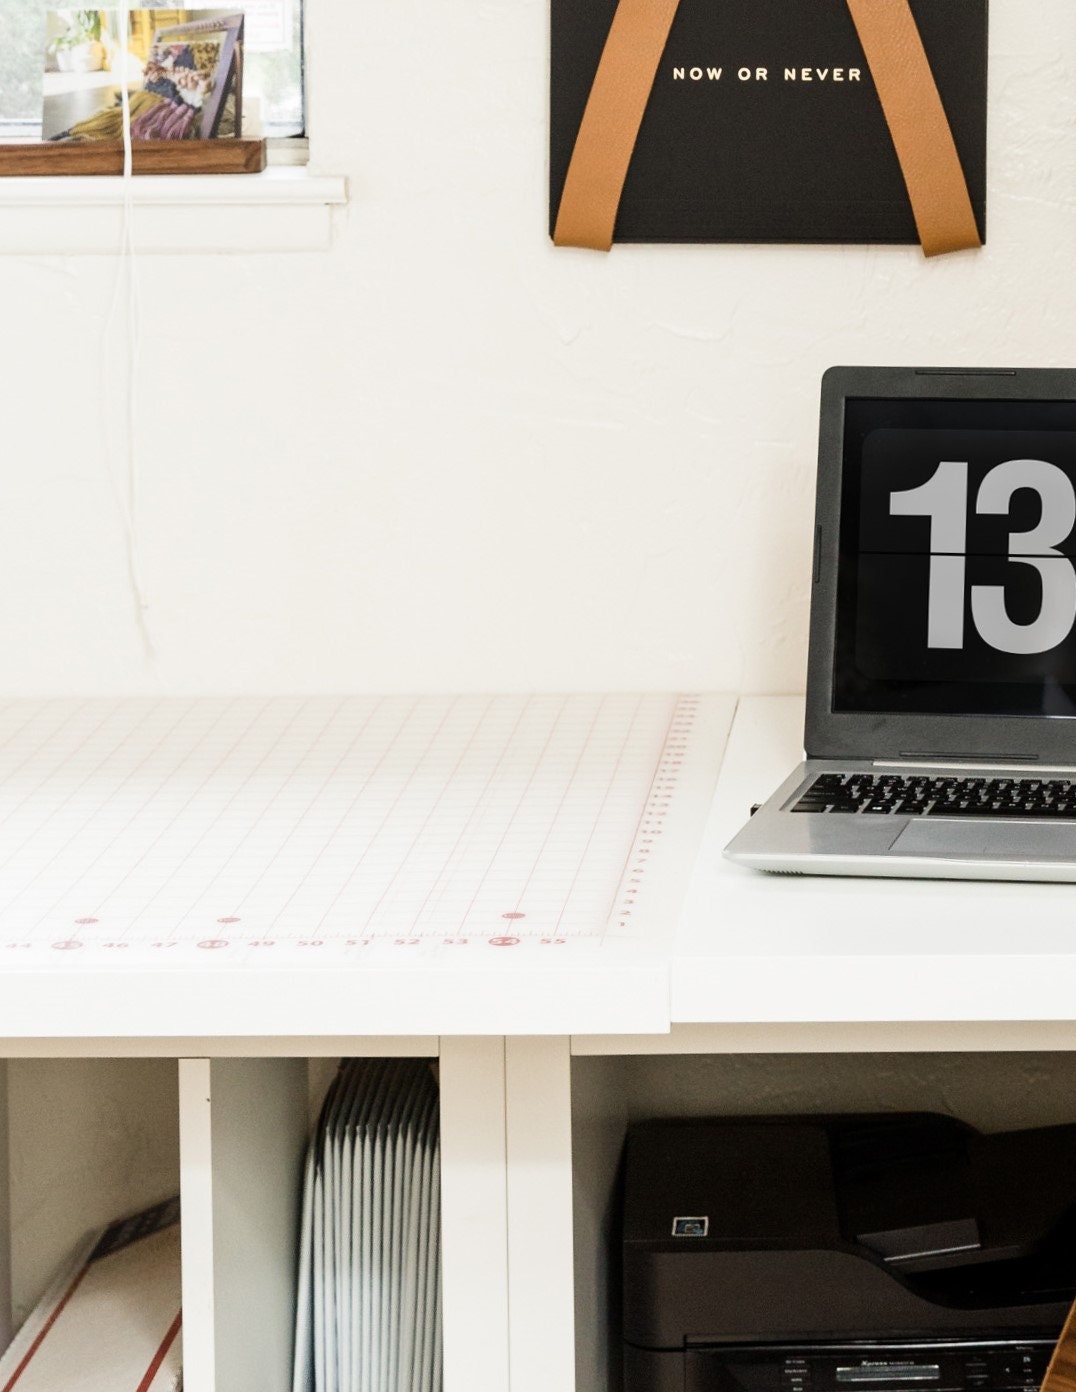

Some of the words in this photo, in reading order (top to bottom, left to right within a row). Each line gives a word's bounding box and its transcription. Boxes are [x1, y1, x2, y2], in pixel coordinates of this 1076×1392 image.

[673, 67, 722, 81] NOW
[737, 67, 768, 81] OR
[784, 67, 861, 82] NEVER
